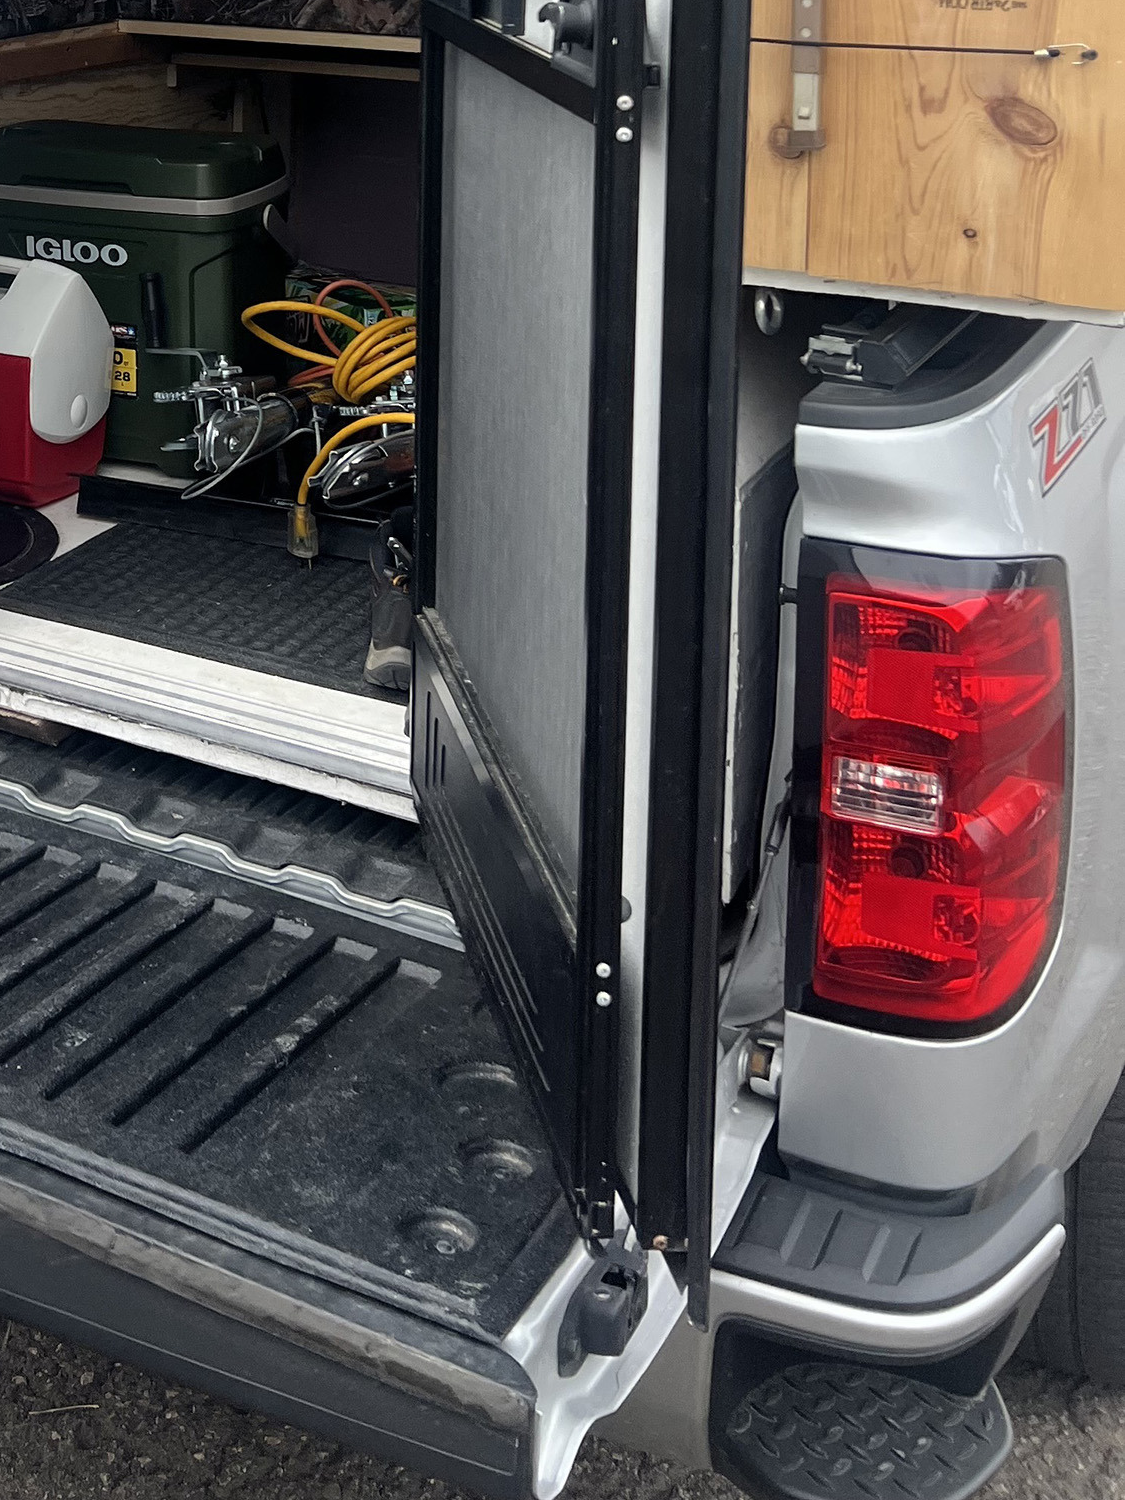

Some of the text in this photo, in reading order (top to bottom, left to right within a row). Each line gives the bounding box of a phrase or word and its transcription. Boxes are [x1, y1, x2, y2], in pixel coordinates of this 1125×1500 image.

[26, 235, 128, 266] IGLOO
[113, 350, 124, 365] 0
[115, 370, 131, 382] 28
[1029, 357, 1105, 498] Z71
